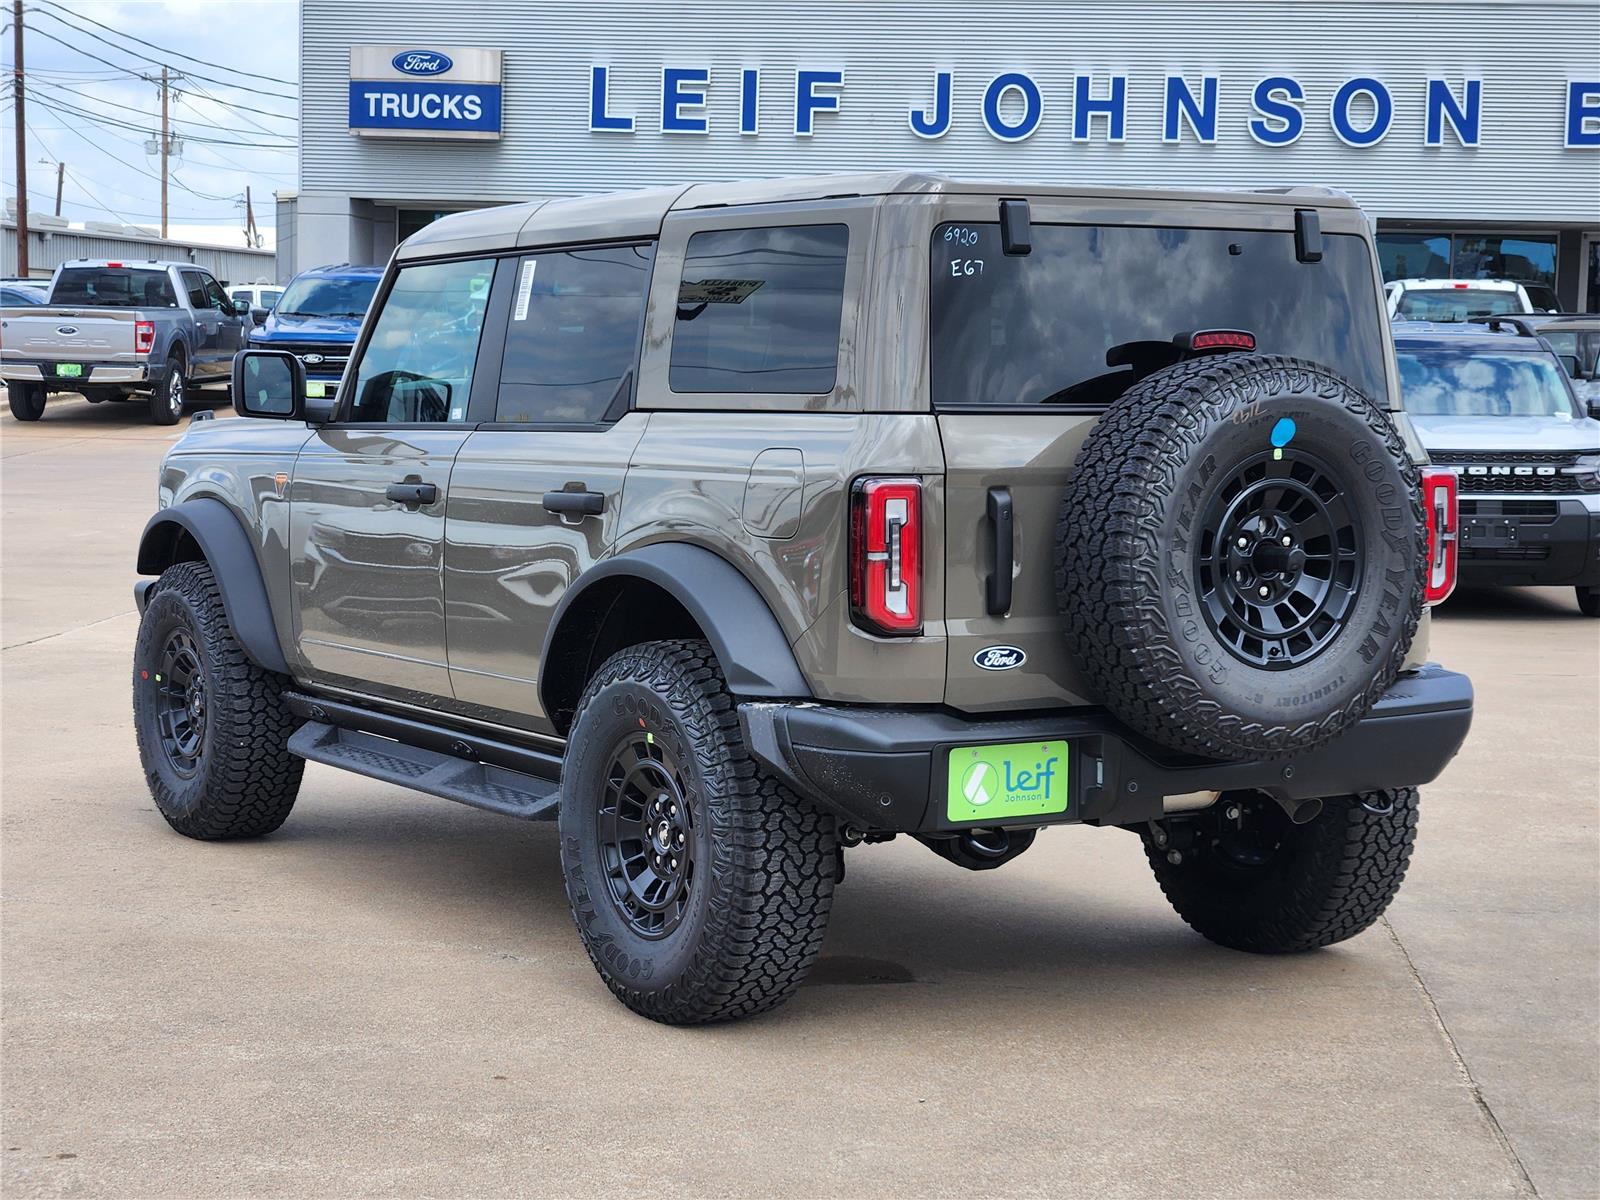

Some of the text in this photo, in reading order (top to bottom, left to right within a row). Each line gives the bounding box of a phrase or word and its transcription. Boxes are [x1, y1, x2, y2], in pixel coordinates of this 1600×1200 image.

[403, 54, 440, 71] Ford
[364, 92, 482, 120] TRUCKS
[589, 65, 845, 136] LEIF
[908, 71, 1484, 149] JOHNSON
[944, 226, 978, 246] 6920
[951, 259, 984, 276] E67
[984, 649, 1018, 667] Ford
[1003, 757, 1058, 799] leif
[1005, 793, 1042, 803] Johnson
